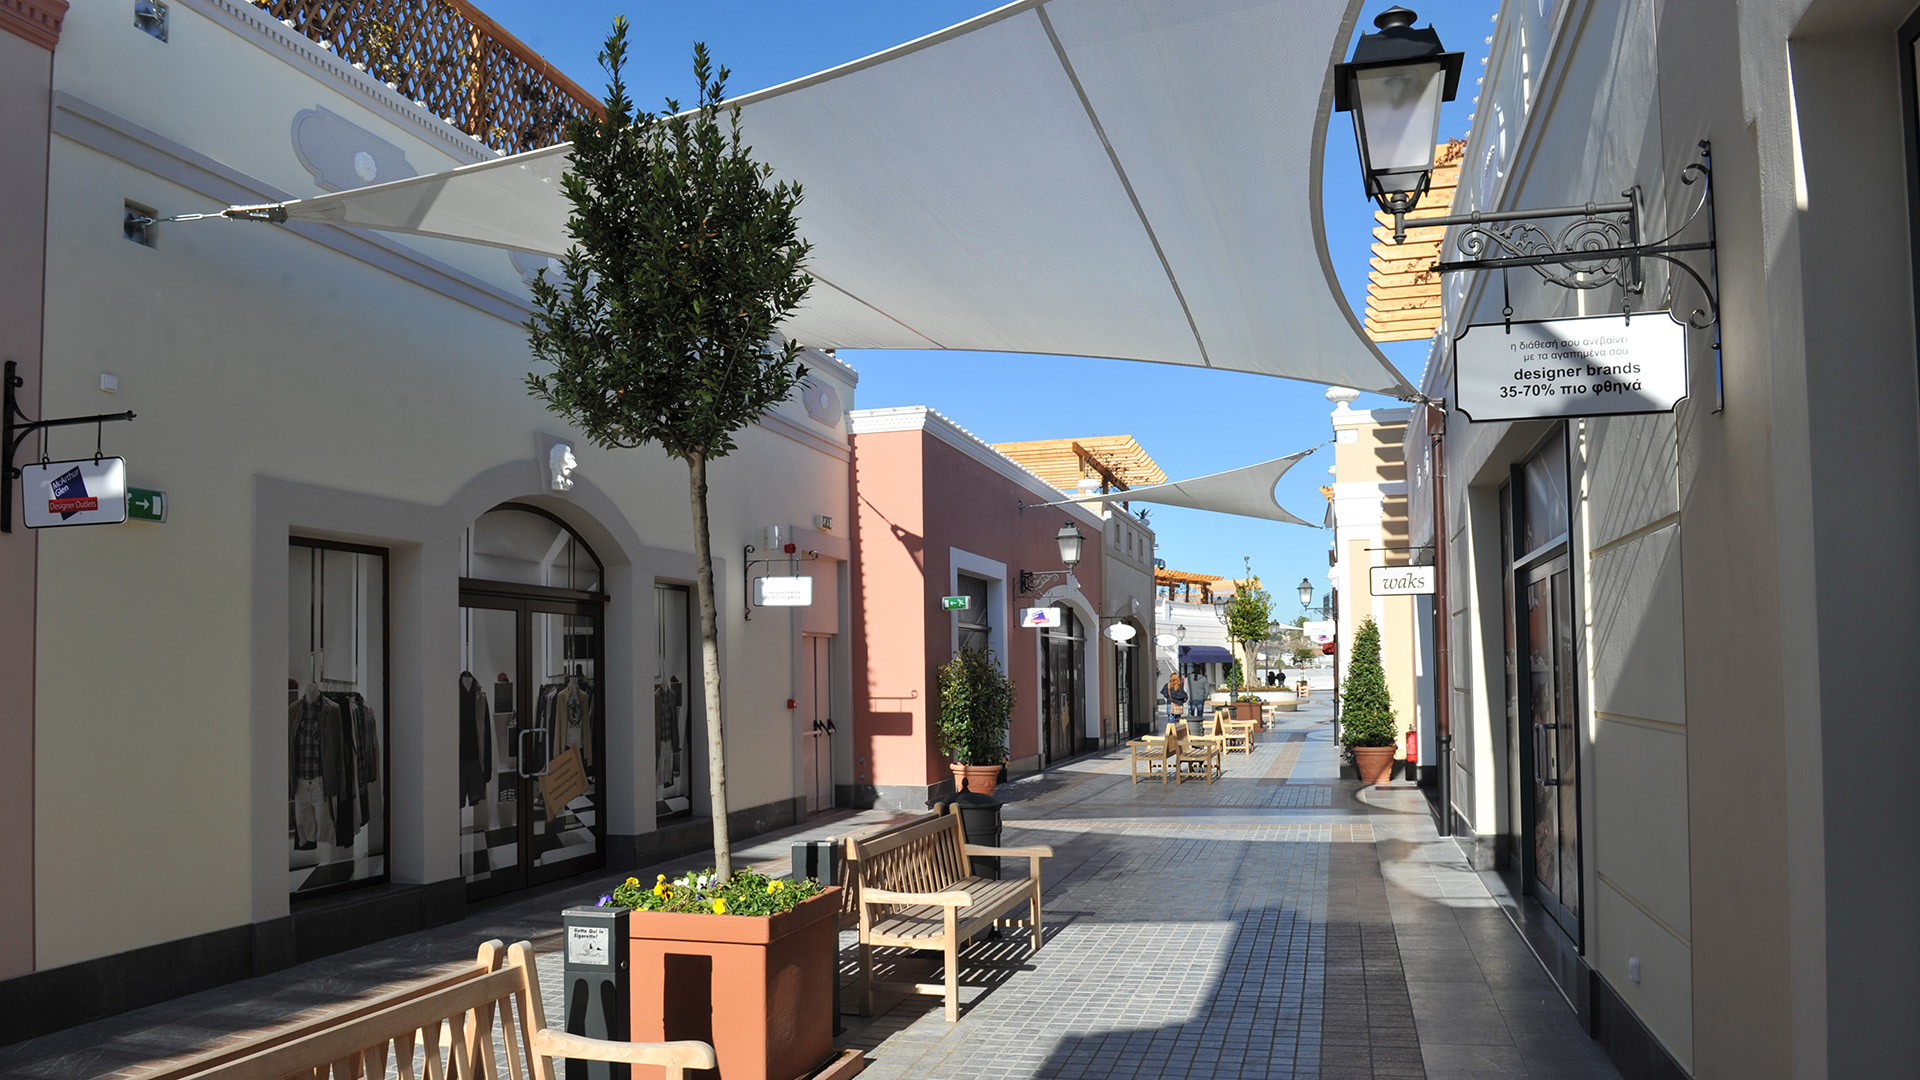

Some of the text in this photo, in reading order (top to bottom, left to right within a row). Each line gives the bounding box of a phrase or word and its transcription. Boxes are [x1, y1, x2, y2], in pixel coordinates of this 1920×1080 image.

[1510, 335, 1628, 352] η διάθεσή σου ανεβαίνει
[1523, 353, 1535, 363] με
[1551, 348, 1606, 361] αγαπημένα
[1609, 348, 1628, 356] σου
[1514, 362, 1641, 381] designer brands
[1499, 379, 1642, 398] 35-70% πιο φθηνά
[52, 469, 79, 490] McArthur
[55, 485, 70, 497] Glen
[49, 500, 96, 511] Designer Outlets
[1383, 572, 1425, 589] waks
